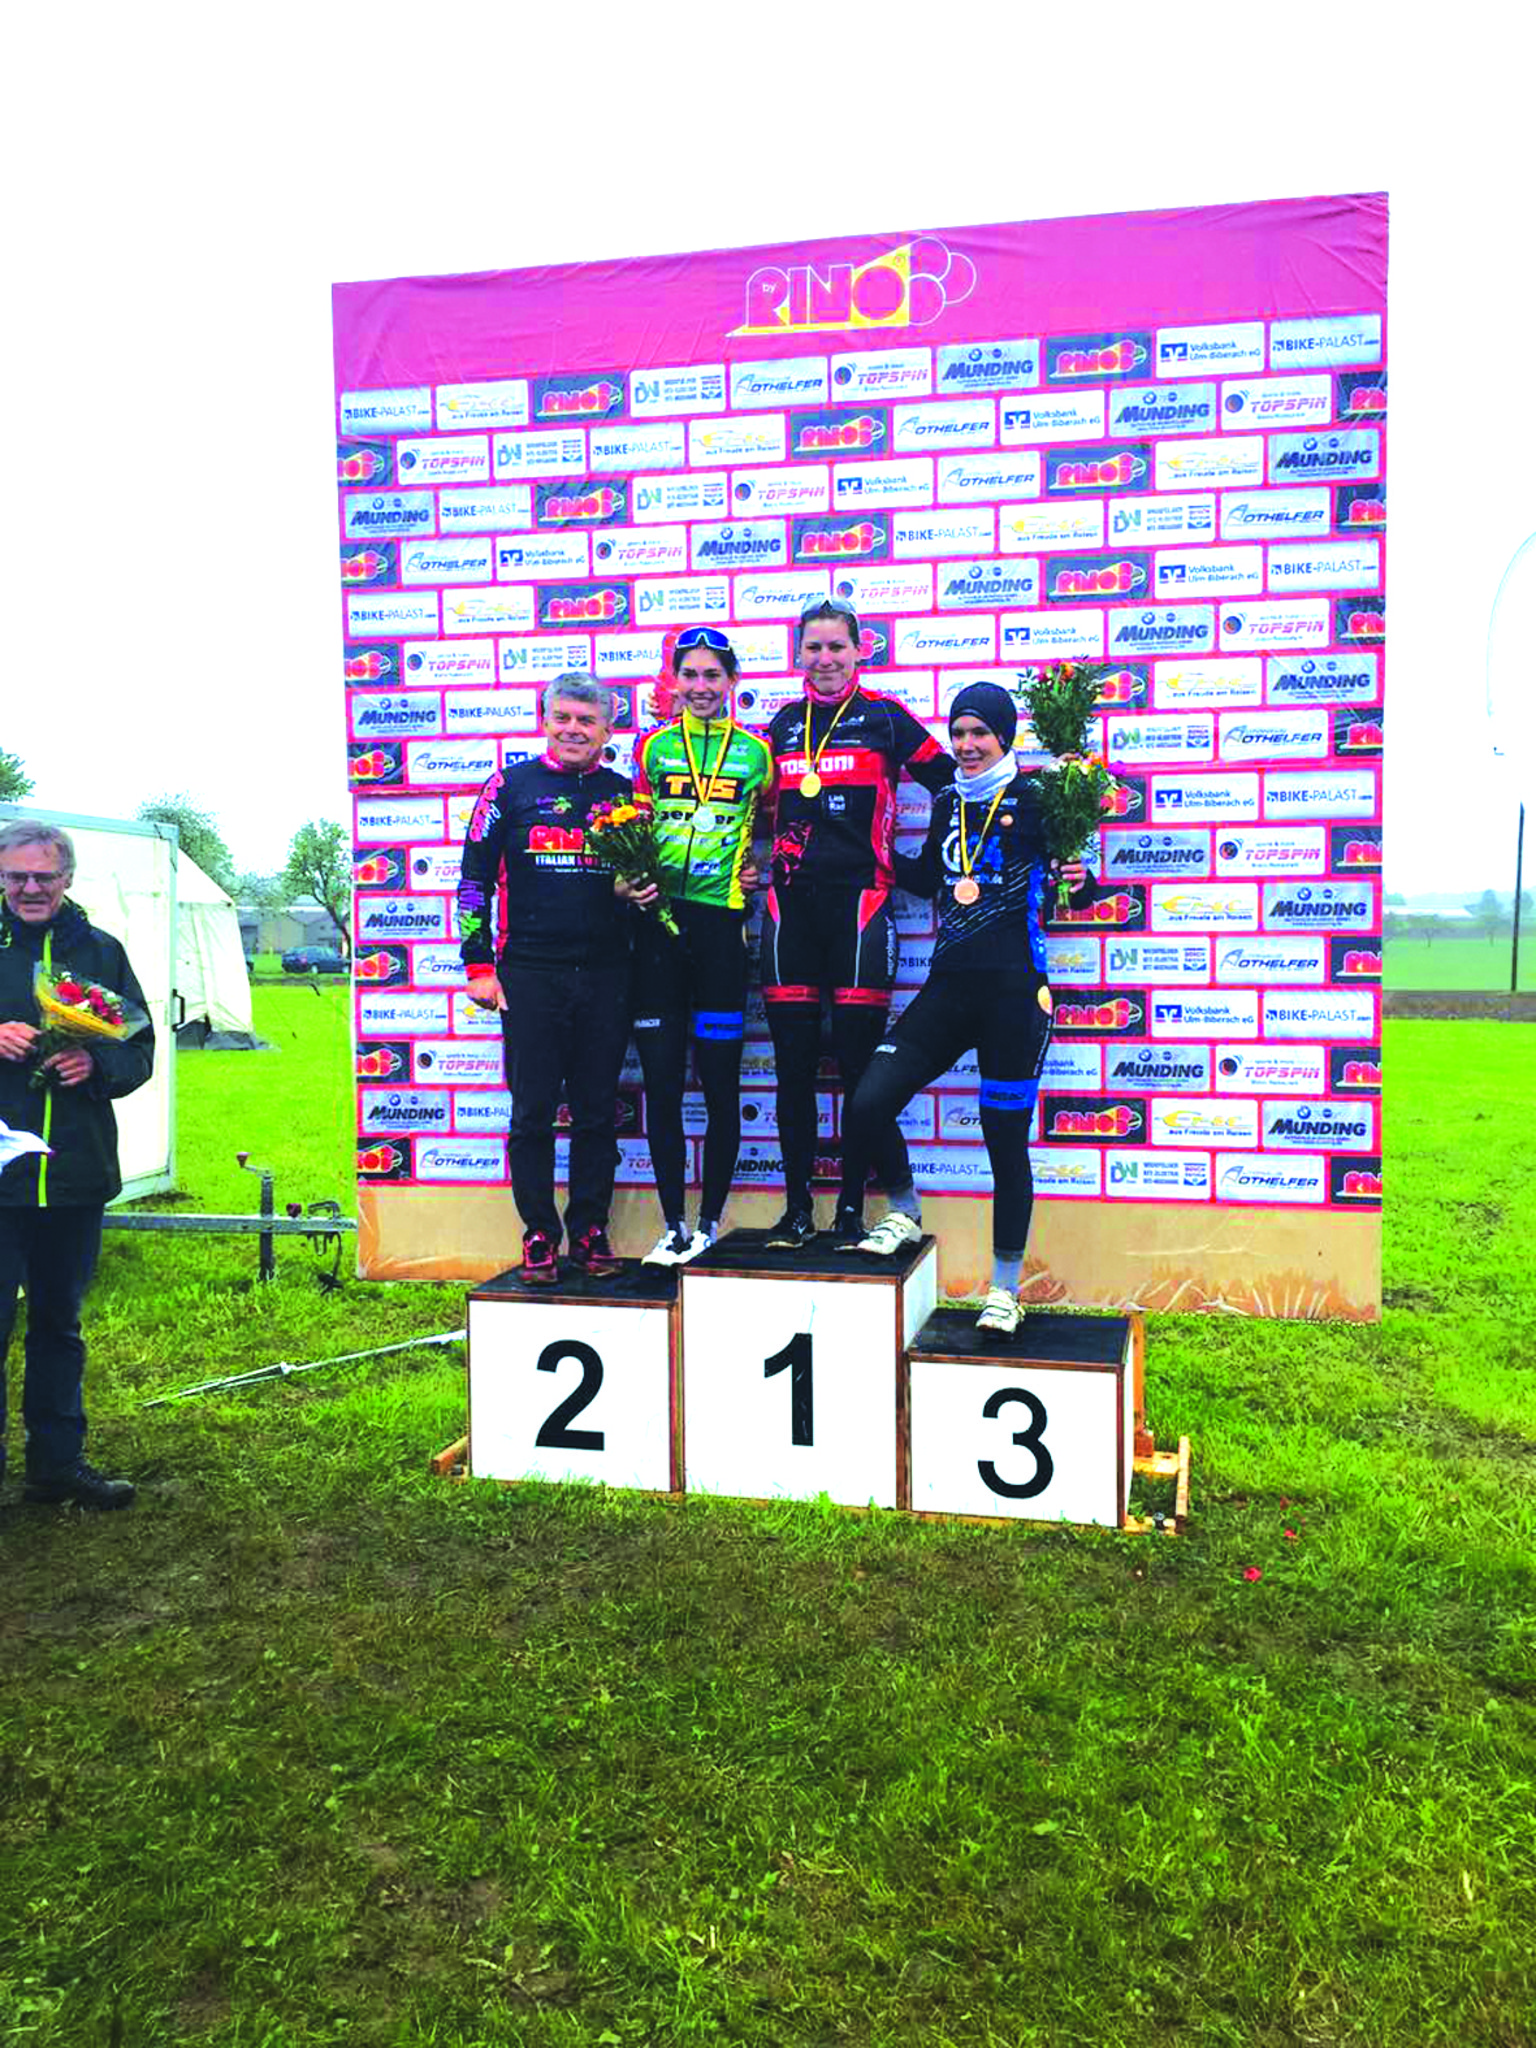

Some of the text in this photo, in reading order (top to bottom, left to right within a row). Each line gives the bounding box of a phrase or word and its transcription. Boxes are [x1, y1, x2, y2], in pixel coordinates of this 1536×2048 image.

[763, 283, 777, 293] by
[942, 360, 1033, 380] MUNDING
[1115, 404, 1210, 422] MUNDING
[1276, 451, 1372, 468] MUNDING
[351, 509, 429, 526] MUNDING
[697, 538, 781, 557] MUNDING
[945, 578, 1033, 596] MUNDING
[1115, 625, 1208, 642] MUNDING
[1273, 674, 1370, 691] MUNDING
[359, 710, 436, 726] MUNDING
[1112, 848, 1204, 865] MUNDING
[1269, 901, 1367, 917] MUNDING
[365, 914, 440, 927] MUNDING
[1185, 1006, 1229, 1015] Volksbank
[1113, 1062, 1204, 1079] MUNDING
[368, 1107, 444, 1120] MUNDING
[1269, 1119, 1366, 1137] MUNDING
[737, 1160, 785, 1172] NDING
[536, 1340, 604, 1451] 2
[764, 1333, 814, 1446] 1
[977, 1388, 1053, 1499] 3
